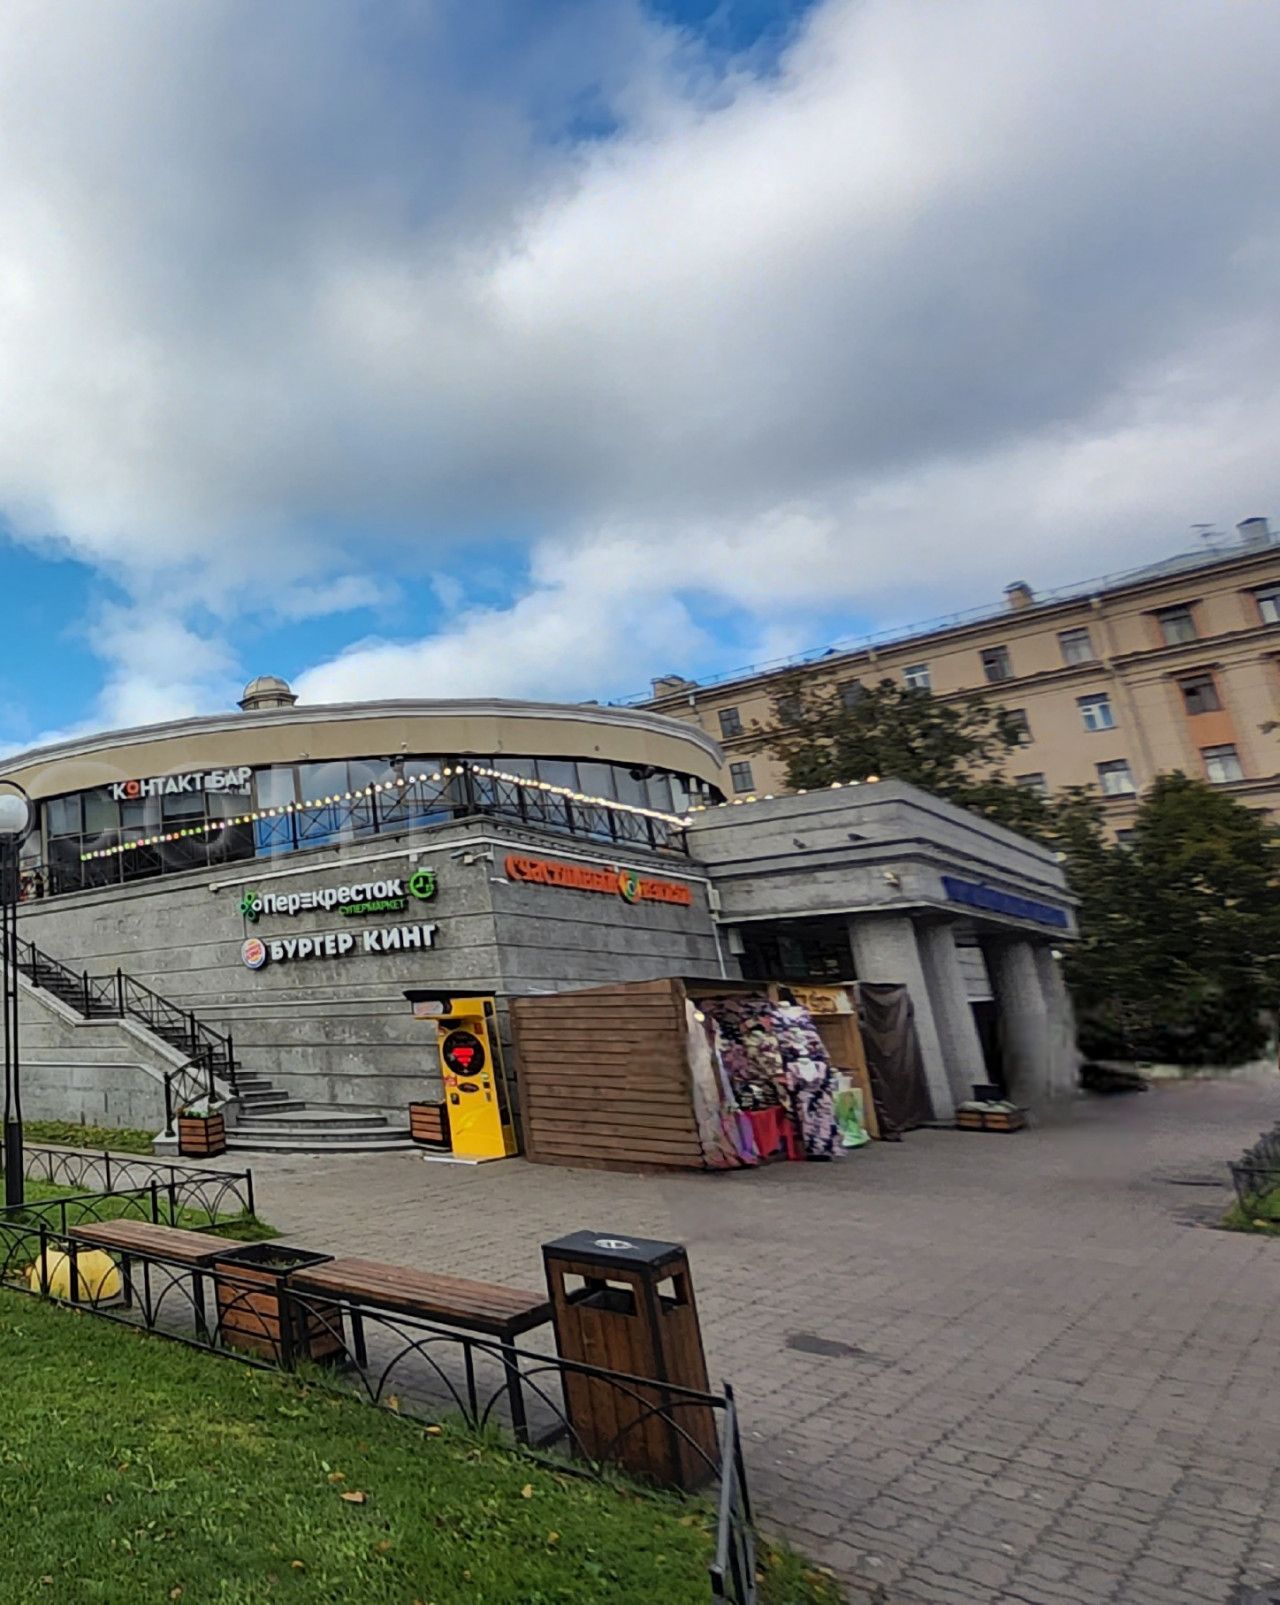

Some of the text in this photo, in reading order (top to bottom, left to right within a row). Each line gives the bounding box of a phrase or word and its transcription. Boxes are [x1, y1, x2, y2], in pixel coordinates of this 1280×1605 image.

[112, 767, 252, 801] КОНТАКТ БАР
[263, 878, 403, 915] Перекресток
[271, 933, 354, 961] БУРГЕР
[363, 924, 436, 951] КИНГ
